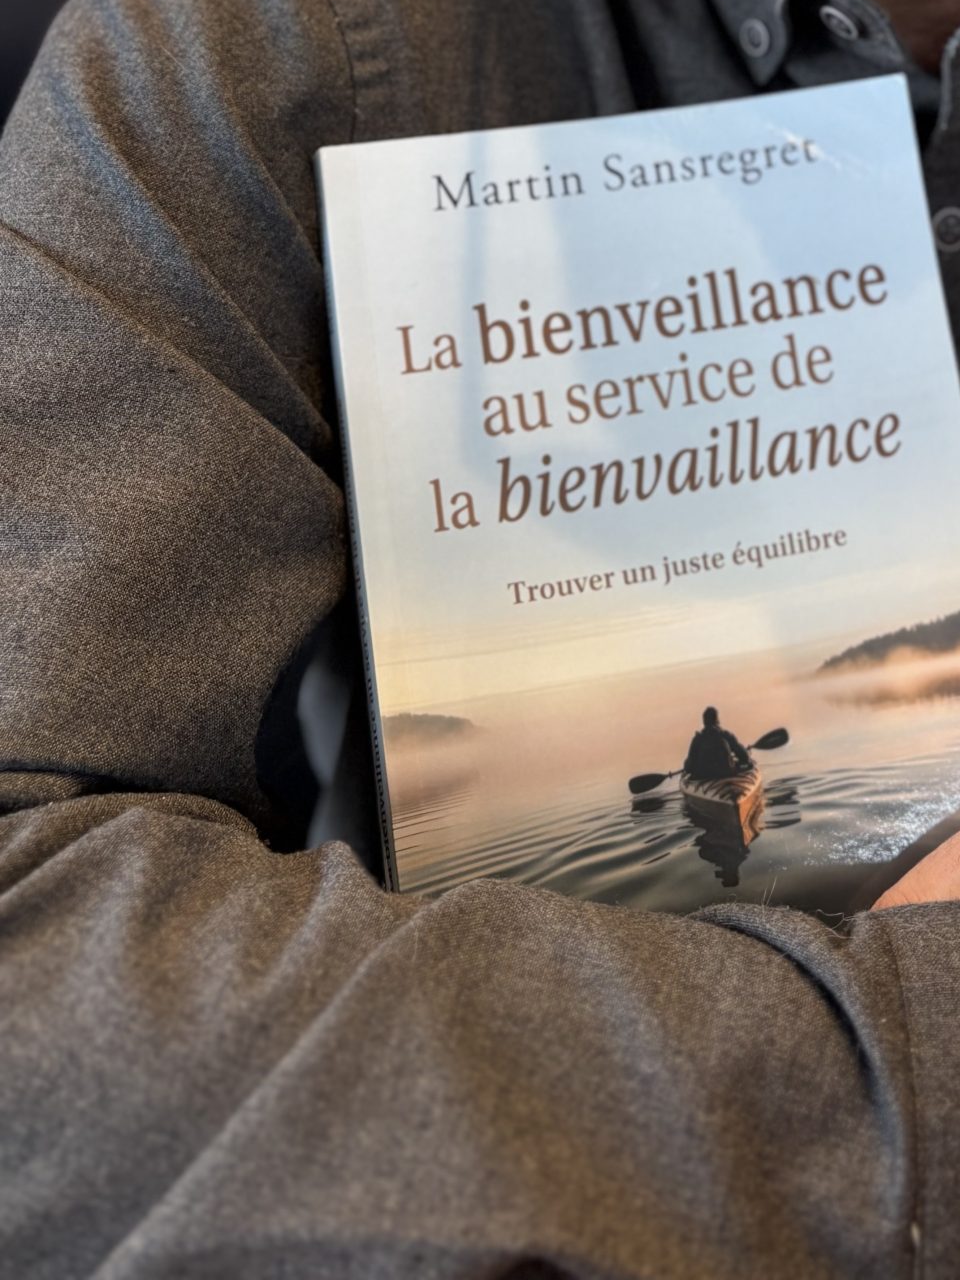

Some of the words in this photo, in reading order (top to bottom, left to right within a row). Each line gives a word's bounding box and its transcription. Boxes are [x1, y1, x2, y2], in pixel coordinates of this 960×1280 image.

[433, 166, 585, 212] Martin
[602, 138, 818, 192] Sansregret
[396, 324, 463, 376] La
[472, 262, 889, 366] bienveillance
[481, 390, 552, 438] au
[565, 352, 757, 425] service
[770, 333, 835, 392] de
[428, 478, 481, 534] la
[496, 412, 903, 524] bienvaillance
[507, 571, 616, 606] Trouver
[621, 564, 657, 586] un
[662, 552, 726, 588] juste
[731, 528, 848, 569] équilibre
